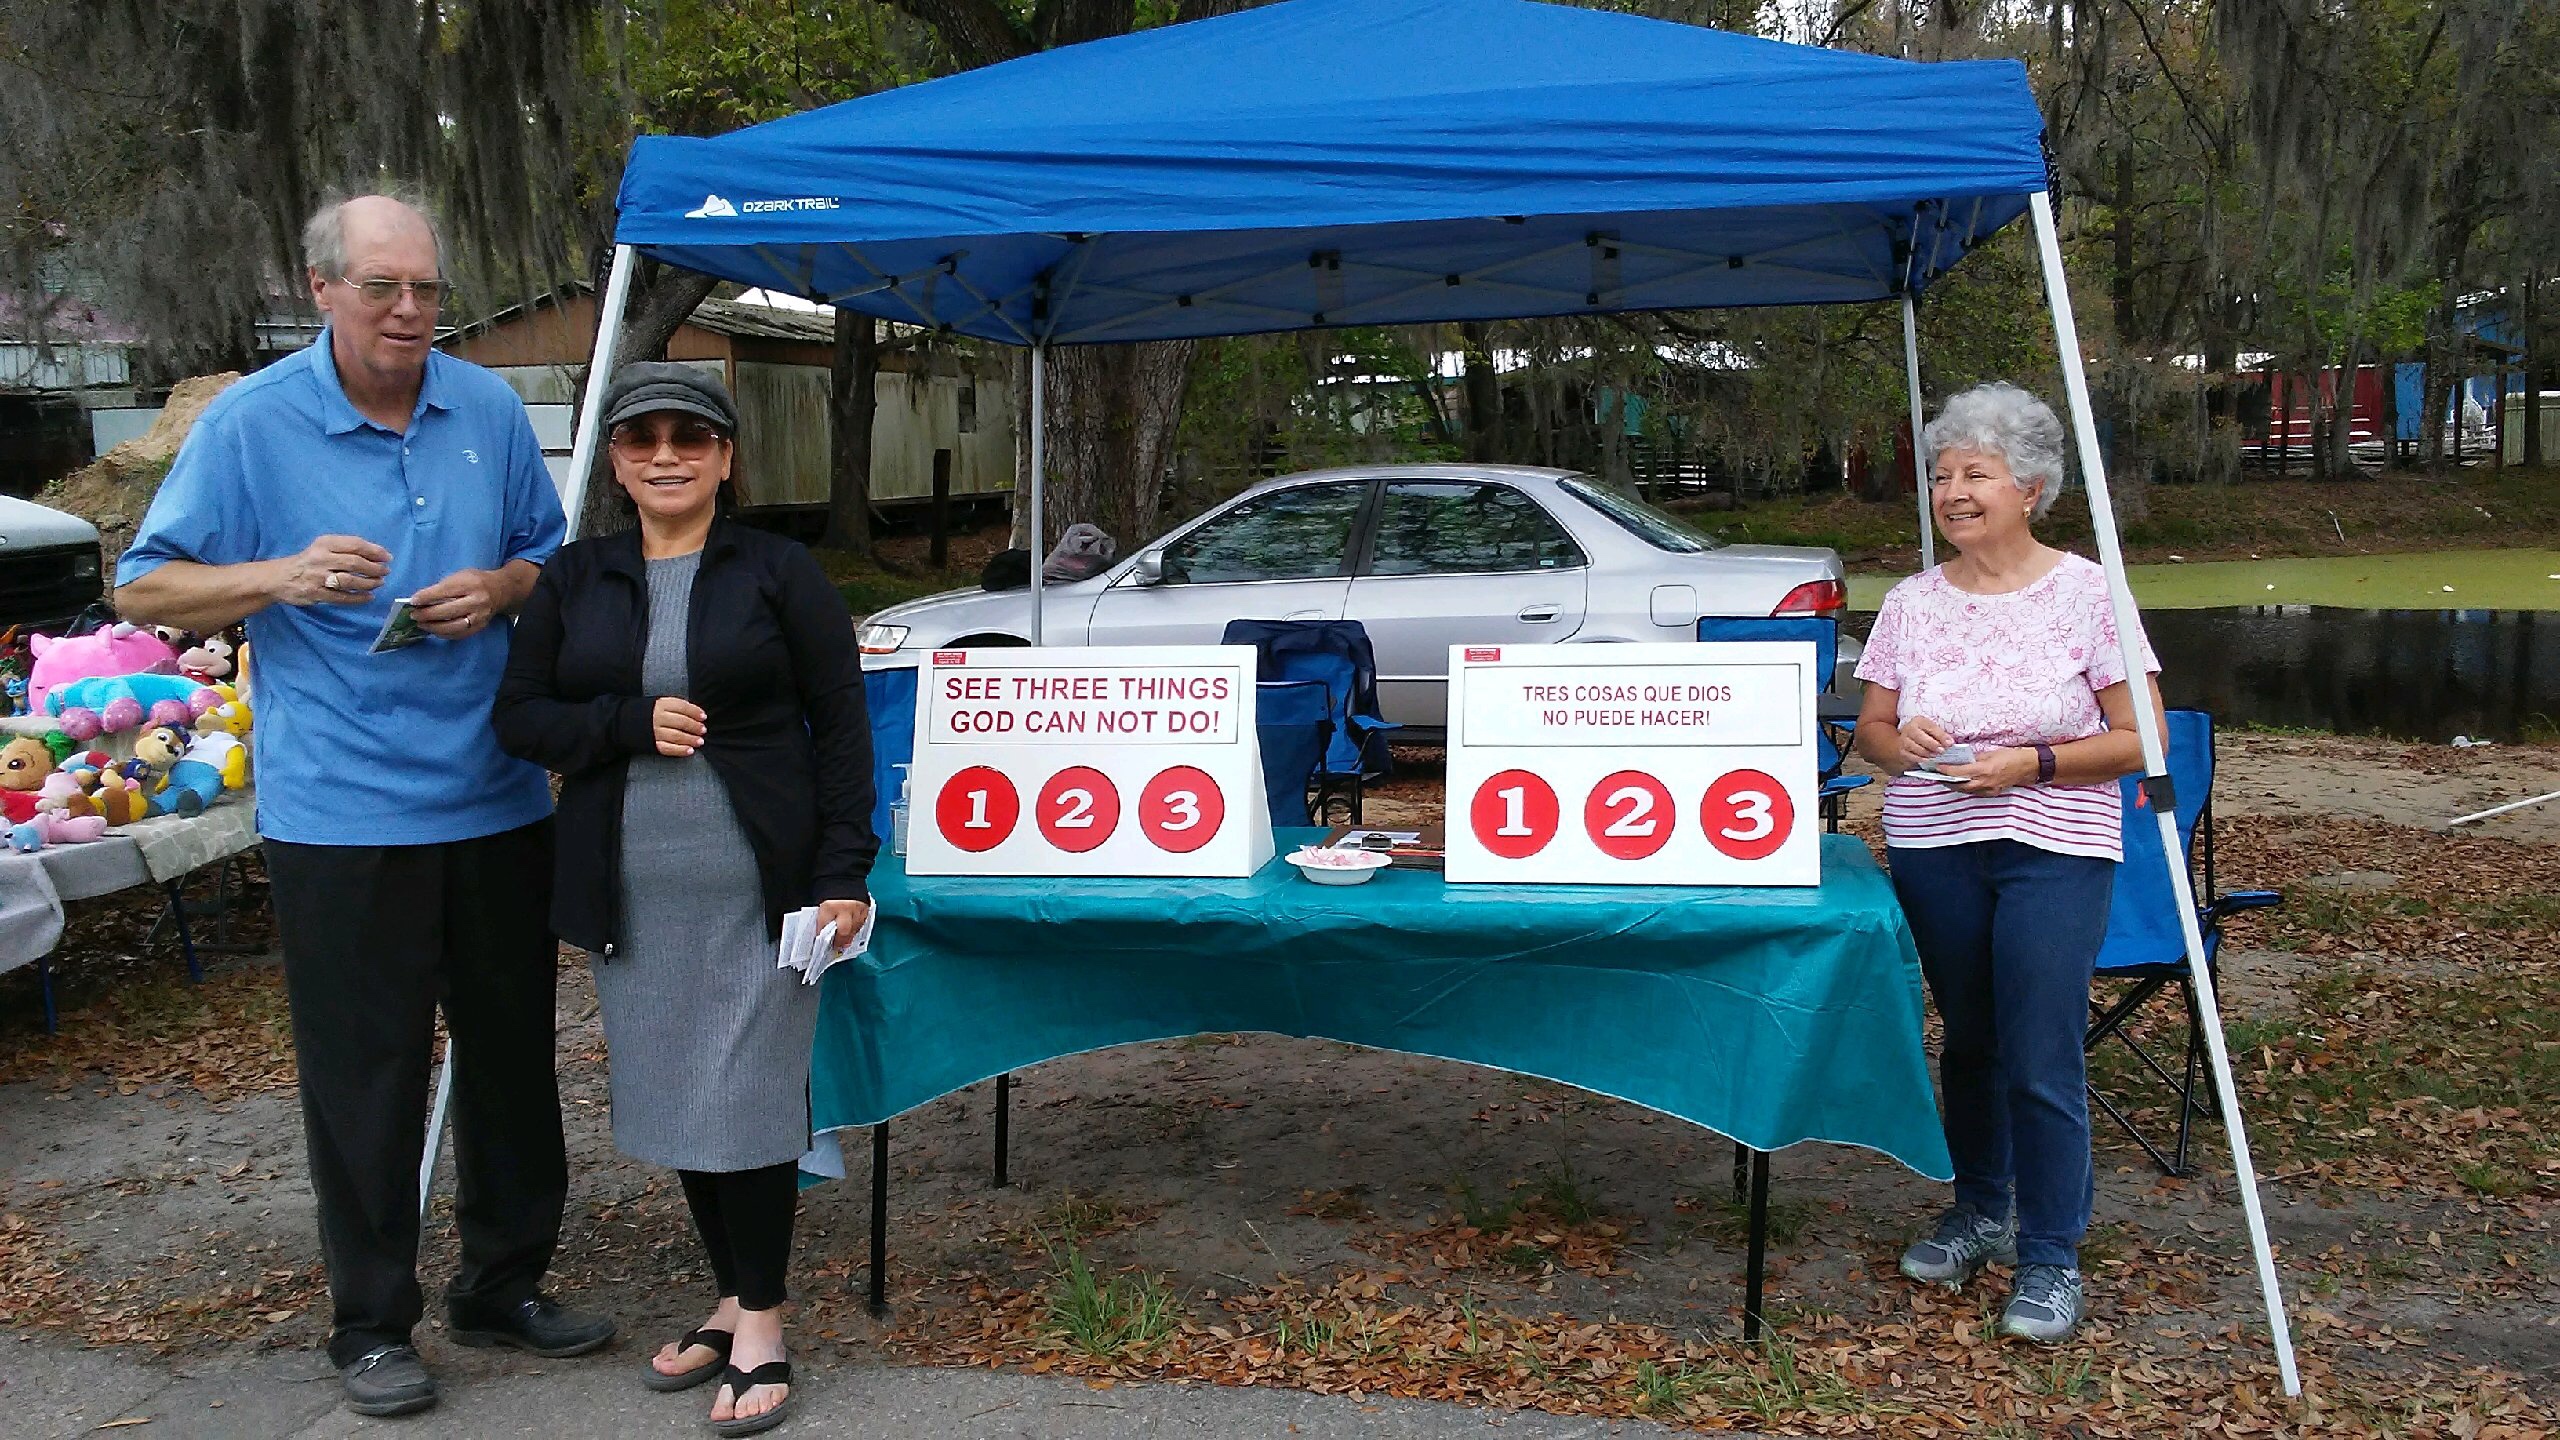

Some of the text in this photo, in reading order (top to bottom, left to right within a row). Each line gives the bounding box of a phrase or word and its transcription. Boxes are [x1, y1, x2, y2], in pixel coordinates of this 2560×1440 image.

[945, 677, 1229, 700] SEE THREE THINGS
[1522, 685, 1732, 703] TRES COSAS QUE DIOS
[950, 710, 1219, 734] GOD CAN NOT DO!
[1542, 710, 1710, 726] NO PUEDE HACER!
[964, 788, 1201, 831] 1 2 3
[1496, 786, 1775, 841] 1 2 3
